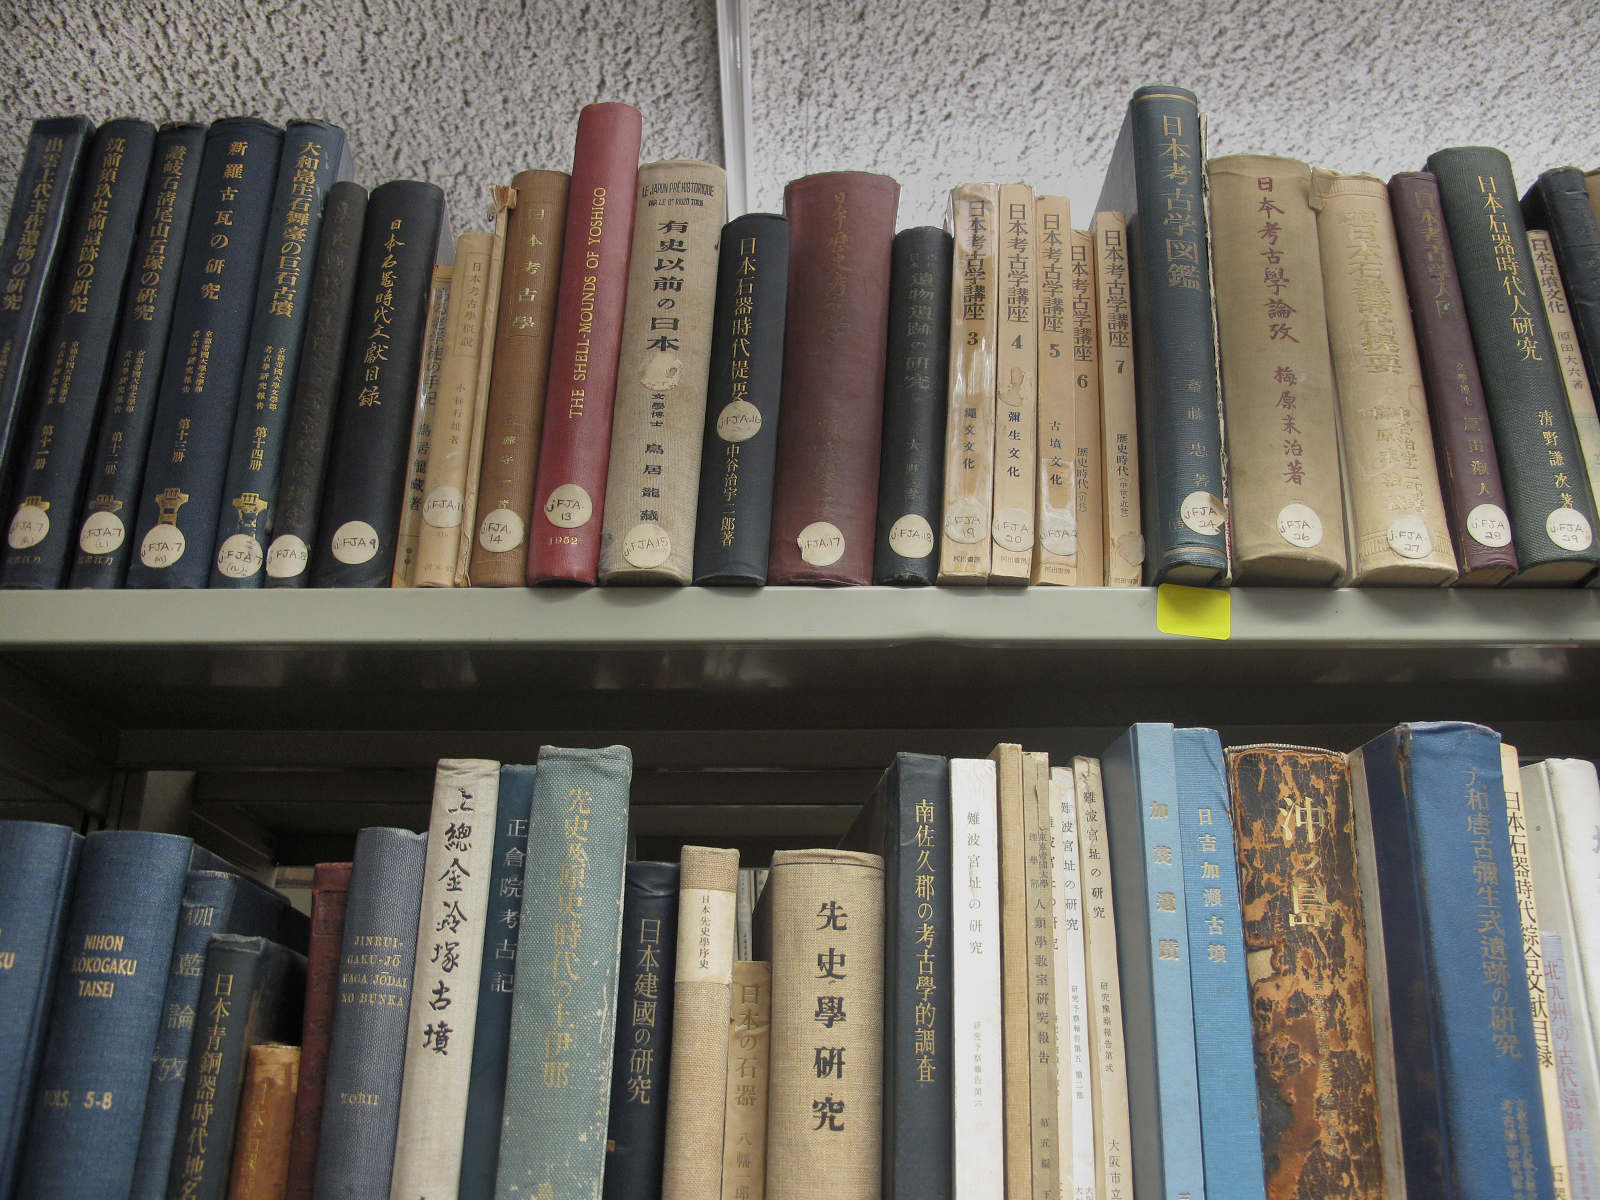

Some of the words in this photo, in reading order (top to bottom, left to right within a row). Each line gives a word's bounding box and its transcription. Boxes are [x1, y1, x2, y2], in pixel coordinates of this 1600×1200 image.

[200, 140, 249, 300] 新羅古瓦の研究
[588, 186, 608, 250] YOSHIGO
[963, 200, 986, 321] 日本考古学講座
[1159, 115, 1204, 292] 日本考古学図鑑
[585, 251, 600, 274] OF
[646, 219, 690, 352] 有史以前の日本
[731, 236, 758, 402] 日本石器時代提要
[1007, 203, 1030, 323] 日本考古学講座
[1042, 213, 1065, 333] 日本考古学講座
[1071, 245, 1094, 362] 日本考古学講座
[1104, 229, 1130, 348] 日本考古学講座
[1478, 174, 1543, 362] 日本石器時代人研究
[1531, 238, 1567, 314] 日本古墳文化
[573, 275, 597, 385] SHELL-MOUNDS
[966, 331, 980, 347] 3
[1010, 334, 1023, 350] 4
[1048, 343, 1061, 359] 5
[1076, 373, 1088, 389] 6
[1115, 359, 1126, 375] 7
[568, 388, 586, 420] THE
[1049, 421, 1064, 486] 古墳文化
[1273, 365, 1303, 486] 梅原末治著
[1538, 409, 1574, 509] 清野謙次著
[1403, 542, 1420, 552] 27
[490, 818, 528, 993] 正倉院考古記
[966, 811, 984, 955] 難波宮址の研究
[1060, 801, 1079, 932] 難波宮址の研究
[1083, 791, 1106, 920] 難波宮址の研究
[1277, 796, 1333, 931] 沖ノ島
[79, 980, 115, 999] TAISEI
[83, 934, 125, 952] NIHON
[341, 992, 355, 1004] NO
[359, 992, 404, 1007] BUNKA
[913, 798, 938, 1086] 南佐久郡の考古學的調査
[627, 918, 662, 1105] 日本建國の研究
[735, 984, 763, 1107] 日本の石器
[812, 900, 848, 1132] 先史學研究
[83, 1091, 114, 1110] 5-8
[340, 1092, 380, 1107] TORII
[1107, 1139, 1122, 1200] 大阪市立
